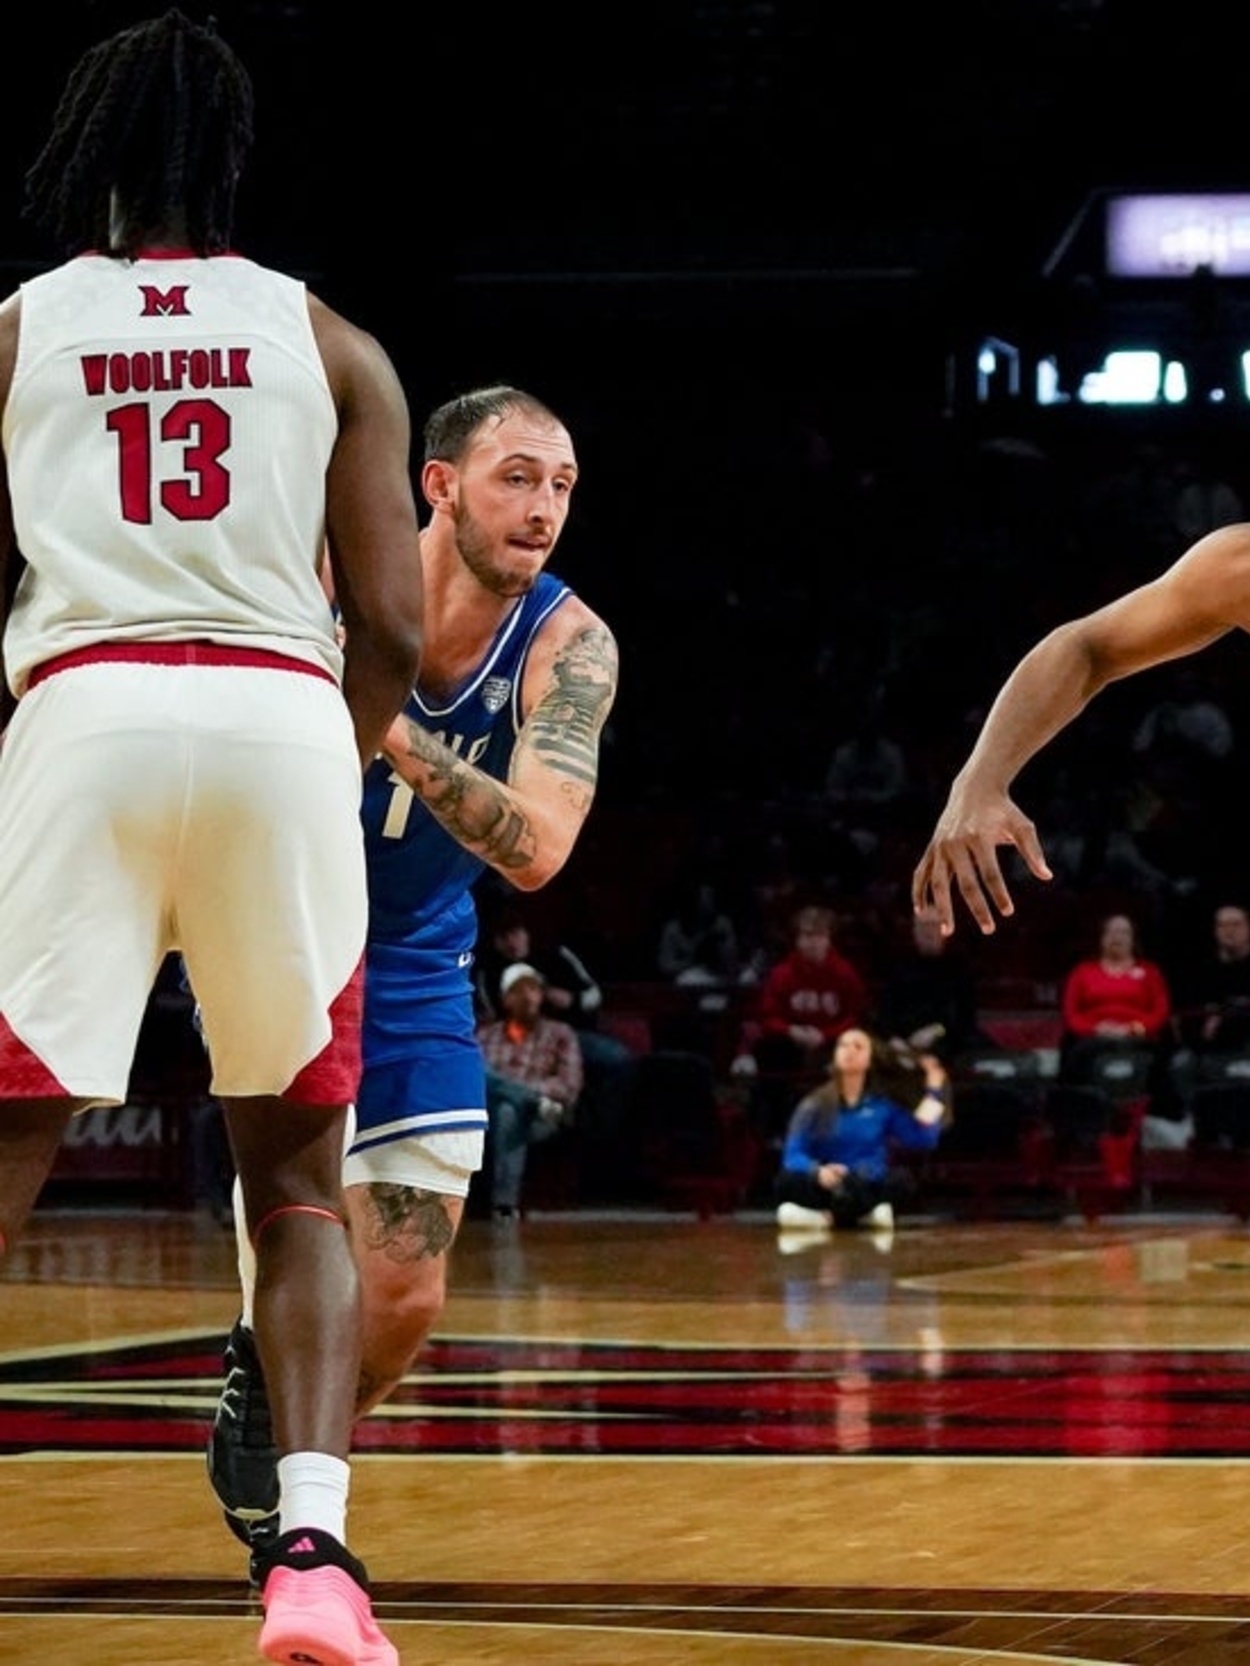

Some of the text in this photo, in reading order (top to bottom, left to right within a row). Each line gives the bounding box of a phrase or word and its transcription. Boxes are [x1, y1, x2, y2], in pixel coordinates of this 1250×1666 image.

[138, 285, 191, 317] M
[80, 348, 252, 396] WOOLFOLK
[106, 398, 231, 525] 13
